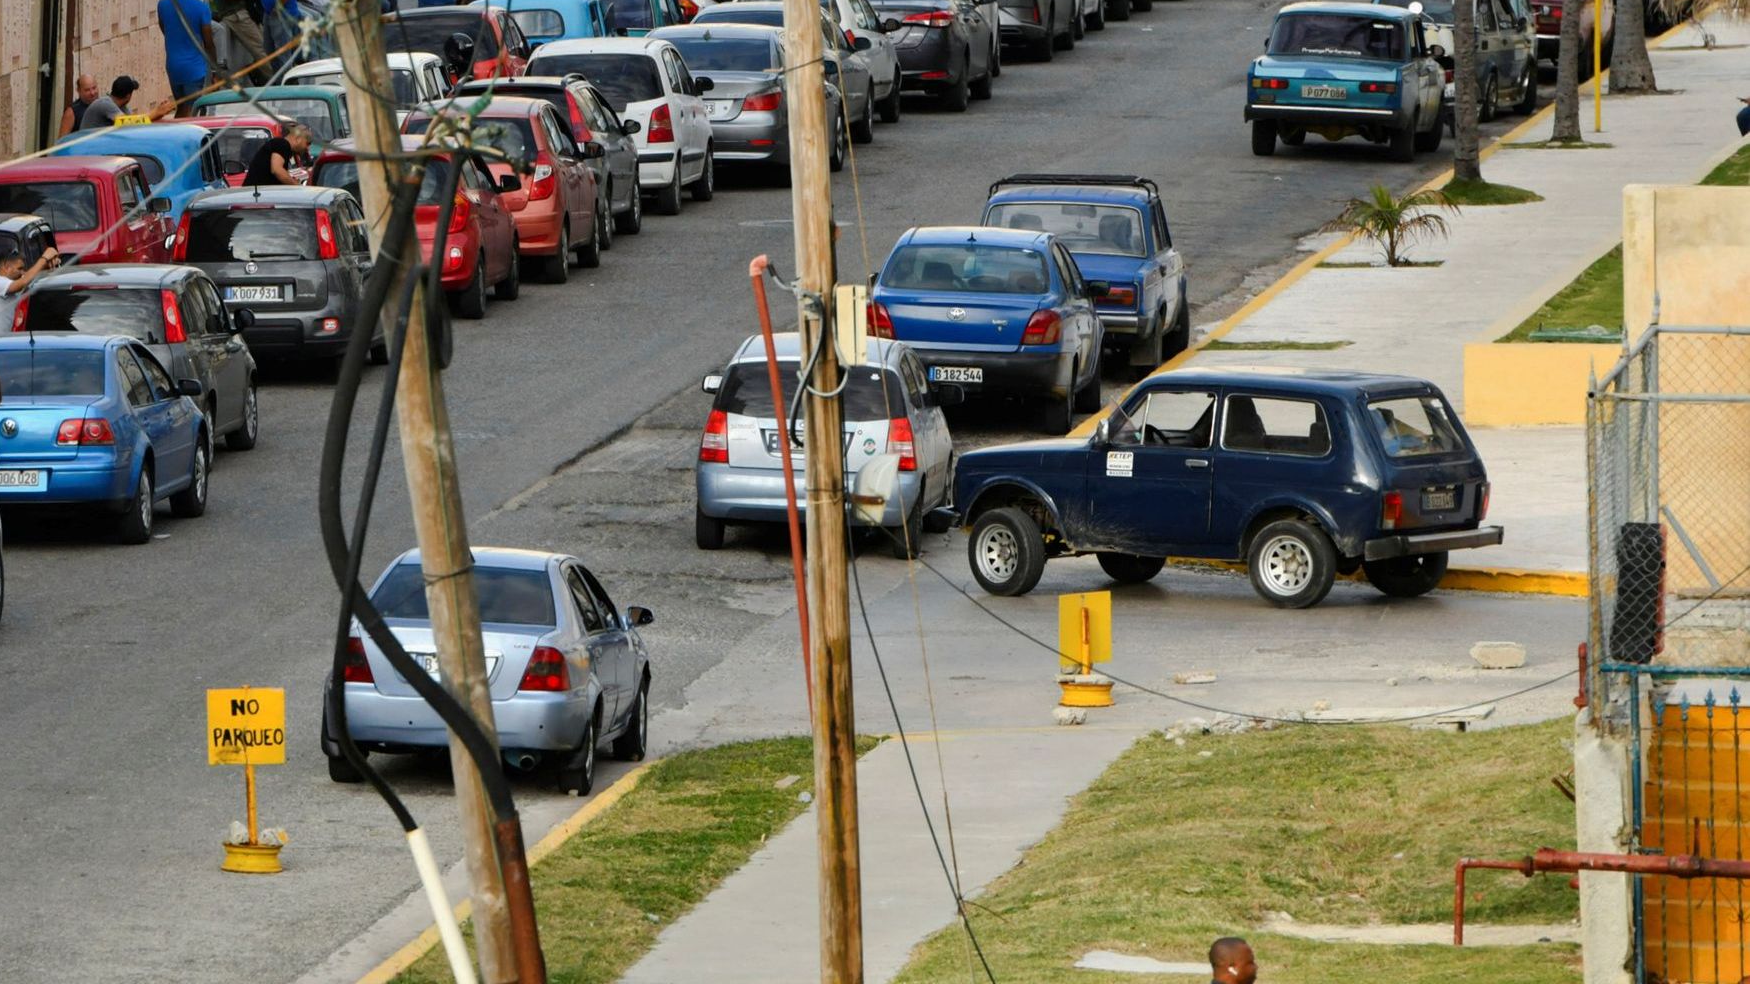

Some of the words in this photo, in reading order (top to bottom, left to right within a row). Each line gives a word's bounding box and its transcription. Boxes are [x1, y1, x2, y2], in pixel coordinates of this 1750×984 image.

[240, 288, 258, 299] 007
[259, 288, 277, 299] 931
[944, 369, 961, 381] 182
[963, 369, 981, 381] 544
[18, 473, 37, 484] 028
[231, 699, 259, 716] NO
[213, 728, 284, 747] PARQUEO
